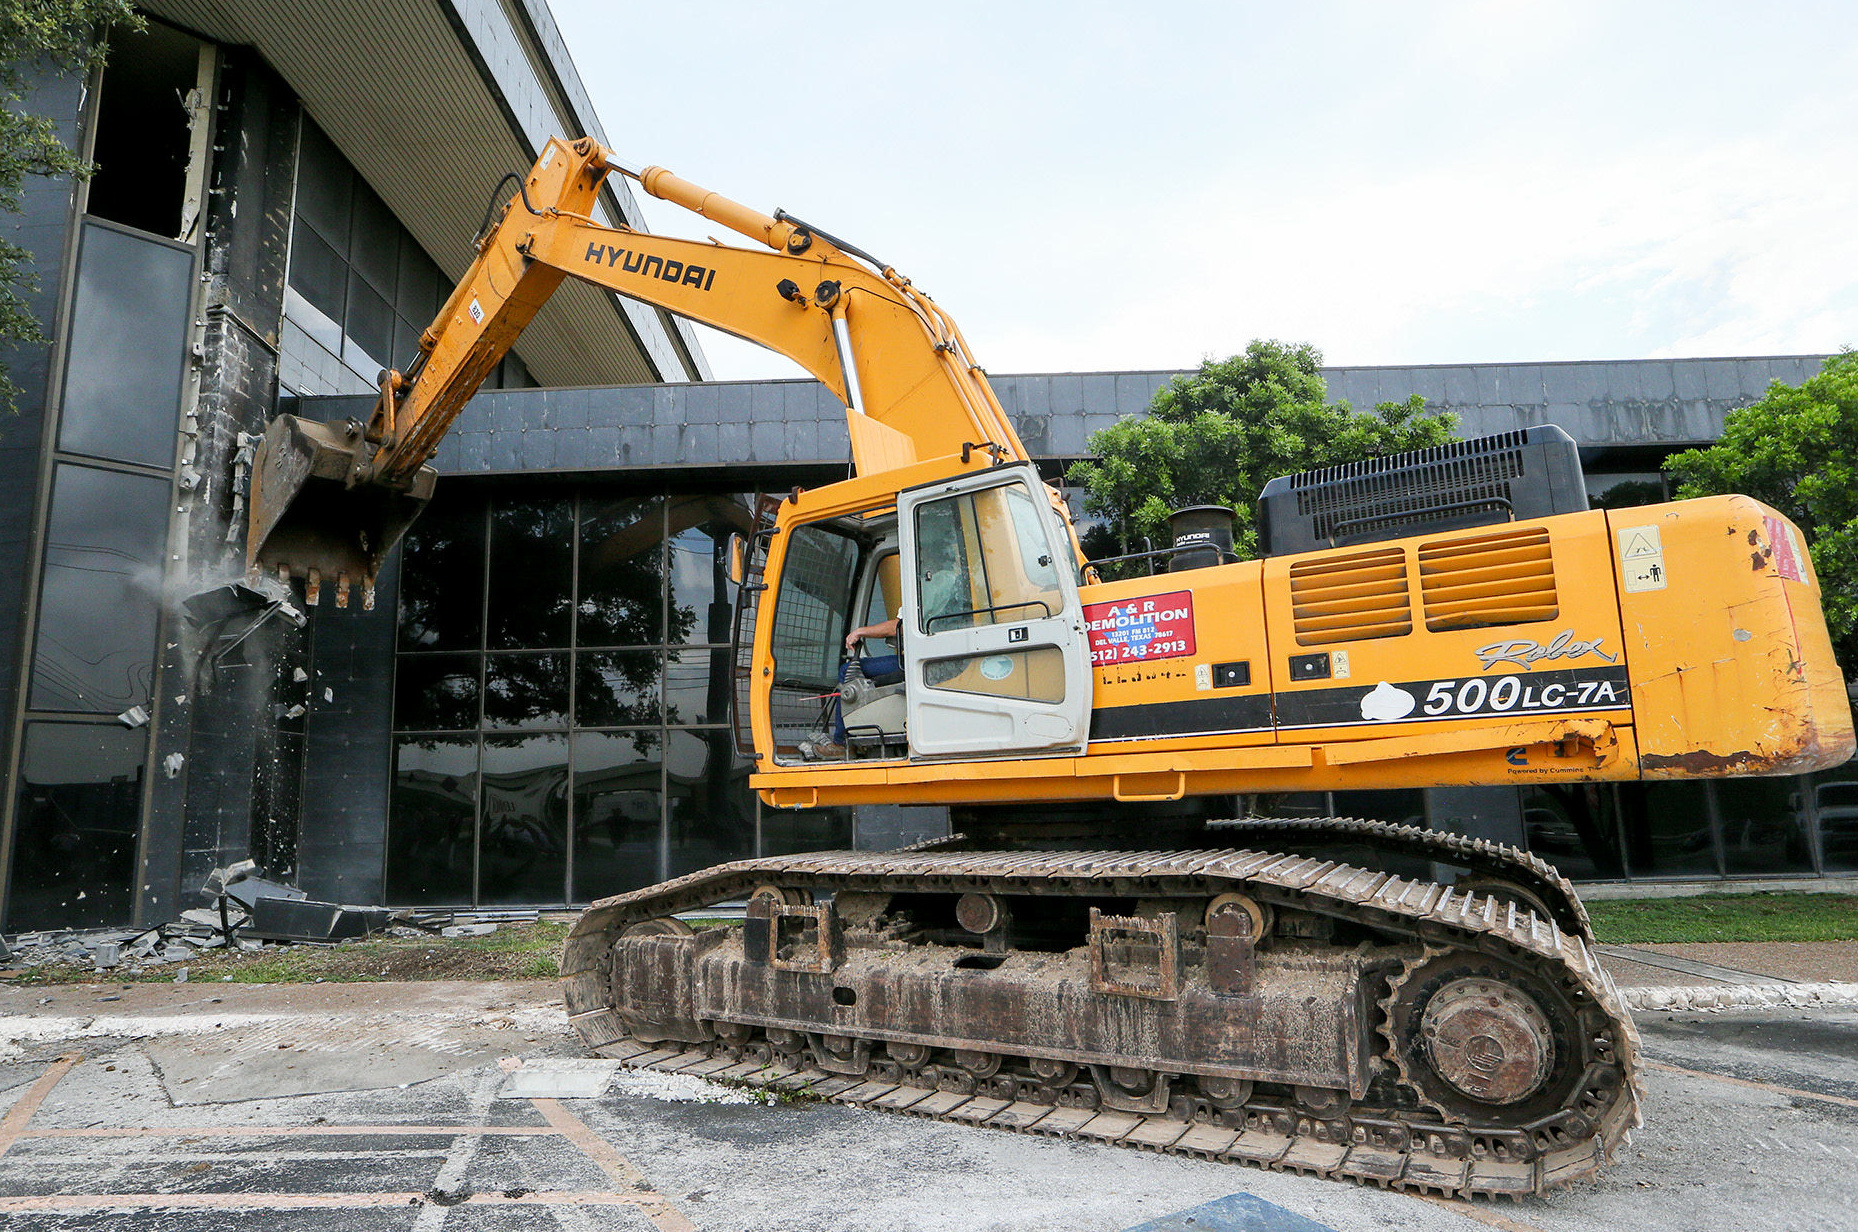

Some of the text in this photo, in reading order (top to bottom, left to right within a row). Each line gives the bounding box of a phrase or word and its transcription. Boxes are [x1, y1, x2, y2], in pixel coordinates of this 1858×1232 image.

[584, 241, 717, 292] HYUNDAI
[1176, 532, 1210, 543] HYUNDAI
[1107, 601, 1155, 618] A & R
[1131, 632, 1152, 641] TEXAS
[1142, 626, 1155, 634] 812
[1091, 640, 1186, 662] 512) 243-2913
[1474, 628, 1618, 671] Robex
[1539, 767, 1548, 775] by
